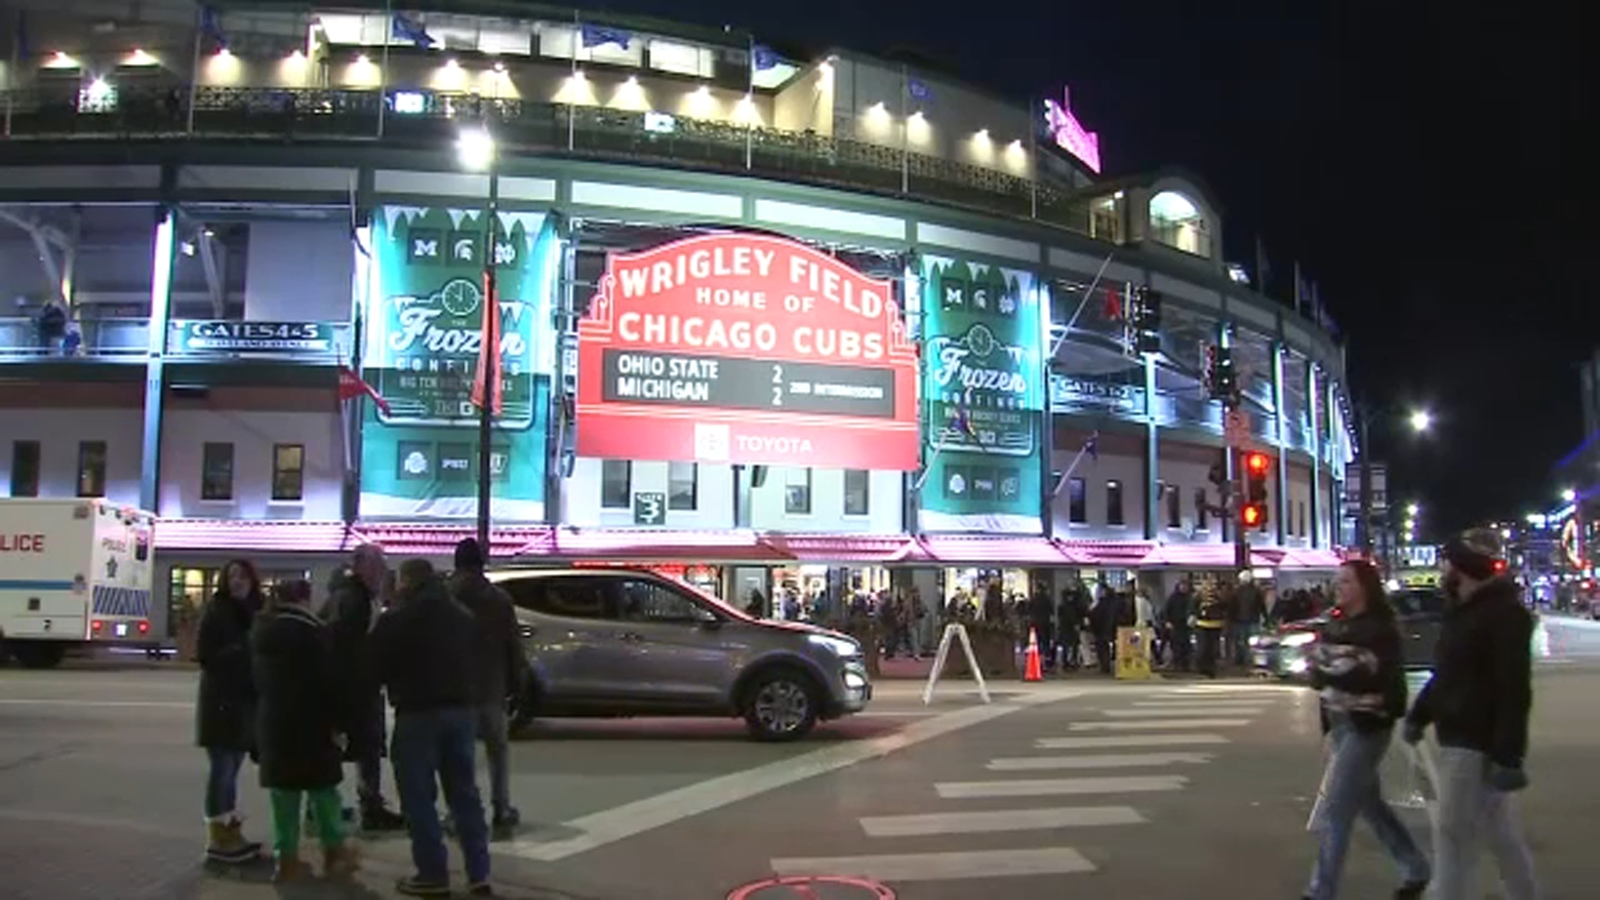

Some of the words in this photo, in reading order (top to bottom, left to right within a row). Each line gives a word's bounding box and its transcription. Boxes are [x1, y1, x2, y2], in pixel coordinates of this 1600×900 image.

[620, 246, 775, 298] WRIGLEY
[790, 254, 883, 319] FIELD
[696, 287, 767, 310] HOME
[784, 294, 816, 313] OF
[388, 305, 527, 356] Frozn
[618, 311, 776, 351] CHICAGO
[793, 326, 883, 359] CUBS
[395, 358, 522, 376] CONFIS
[617, 355, 665, 376] OHIO
[669, 358, 719, 379] STATE
[772, 365, 783, 383] 2
[934, 346, 1027, 394] Frozen
[617, 376, 709, 401] MICHIGAN
[772, 387, 783, 405] 2
[736, 435, 814, 454] TOYOTA
[640, 501, 660, 519] 3
